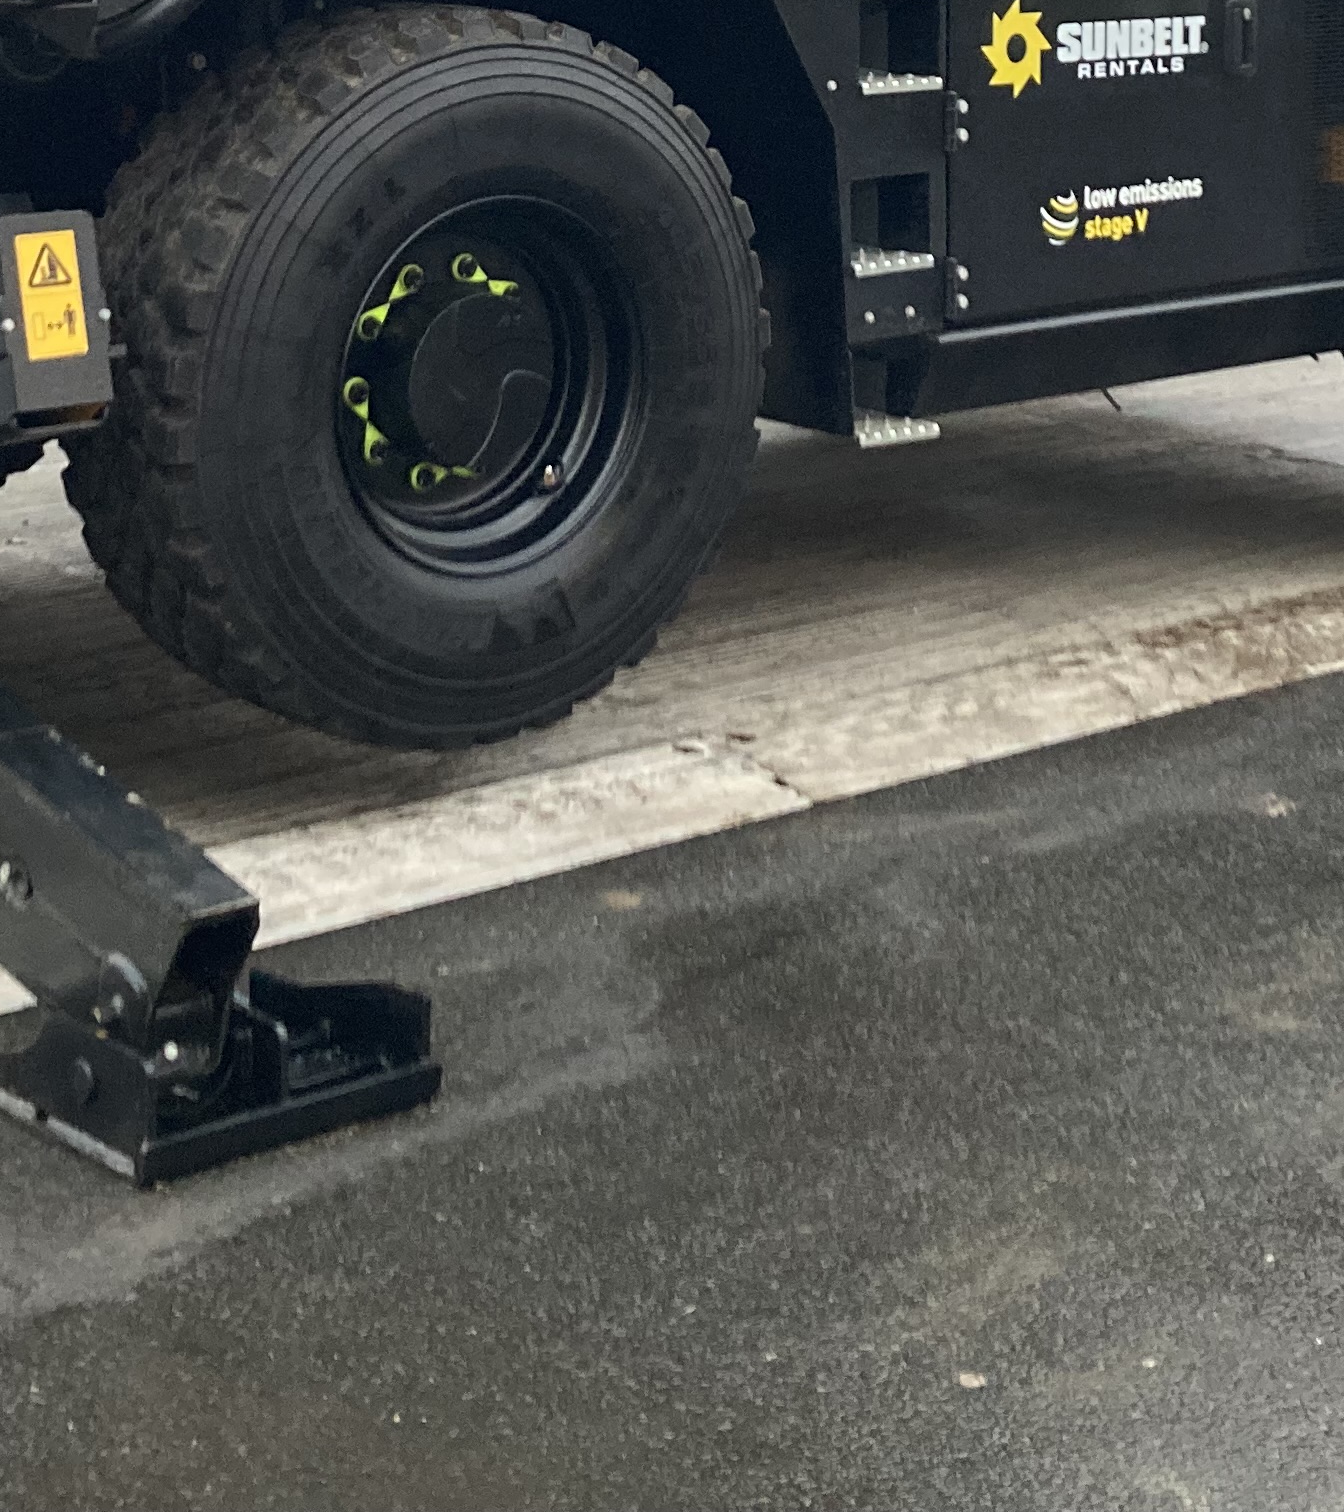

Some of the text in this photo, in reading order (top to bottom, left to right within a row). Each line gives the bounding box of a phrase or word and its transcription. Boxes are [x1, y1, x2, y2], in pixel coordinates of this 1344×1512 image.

[1056, 15, 1206, 63] SUNBELT
[1077, 56, 1185, 79] RENTALS
[1084, 175, 1203, 210] low emissions
[1084, 207, 1149, 241] stage V
